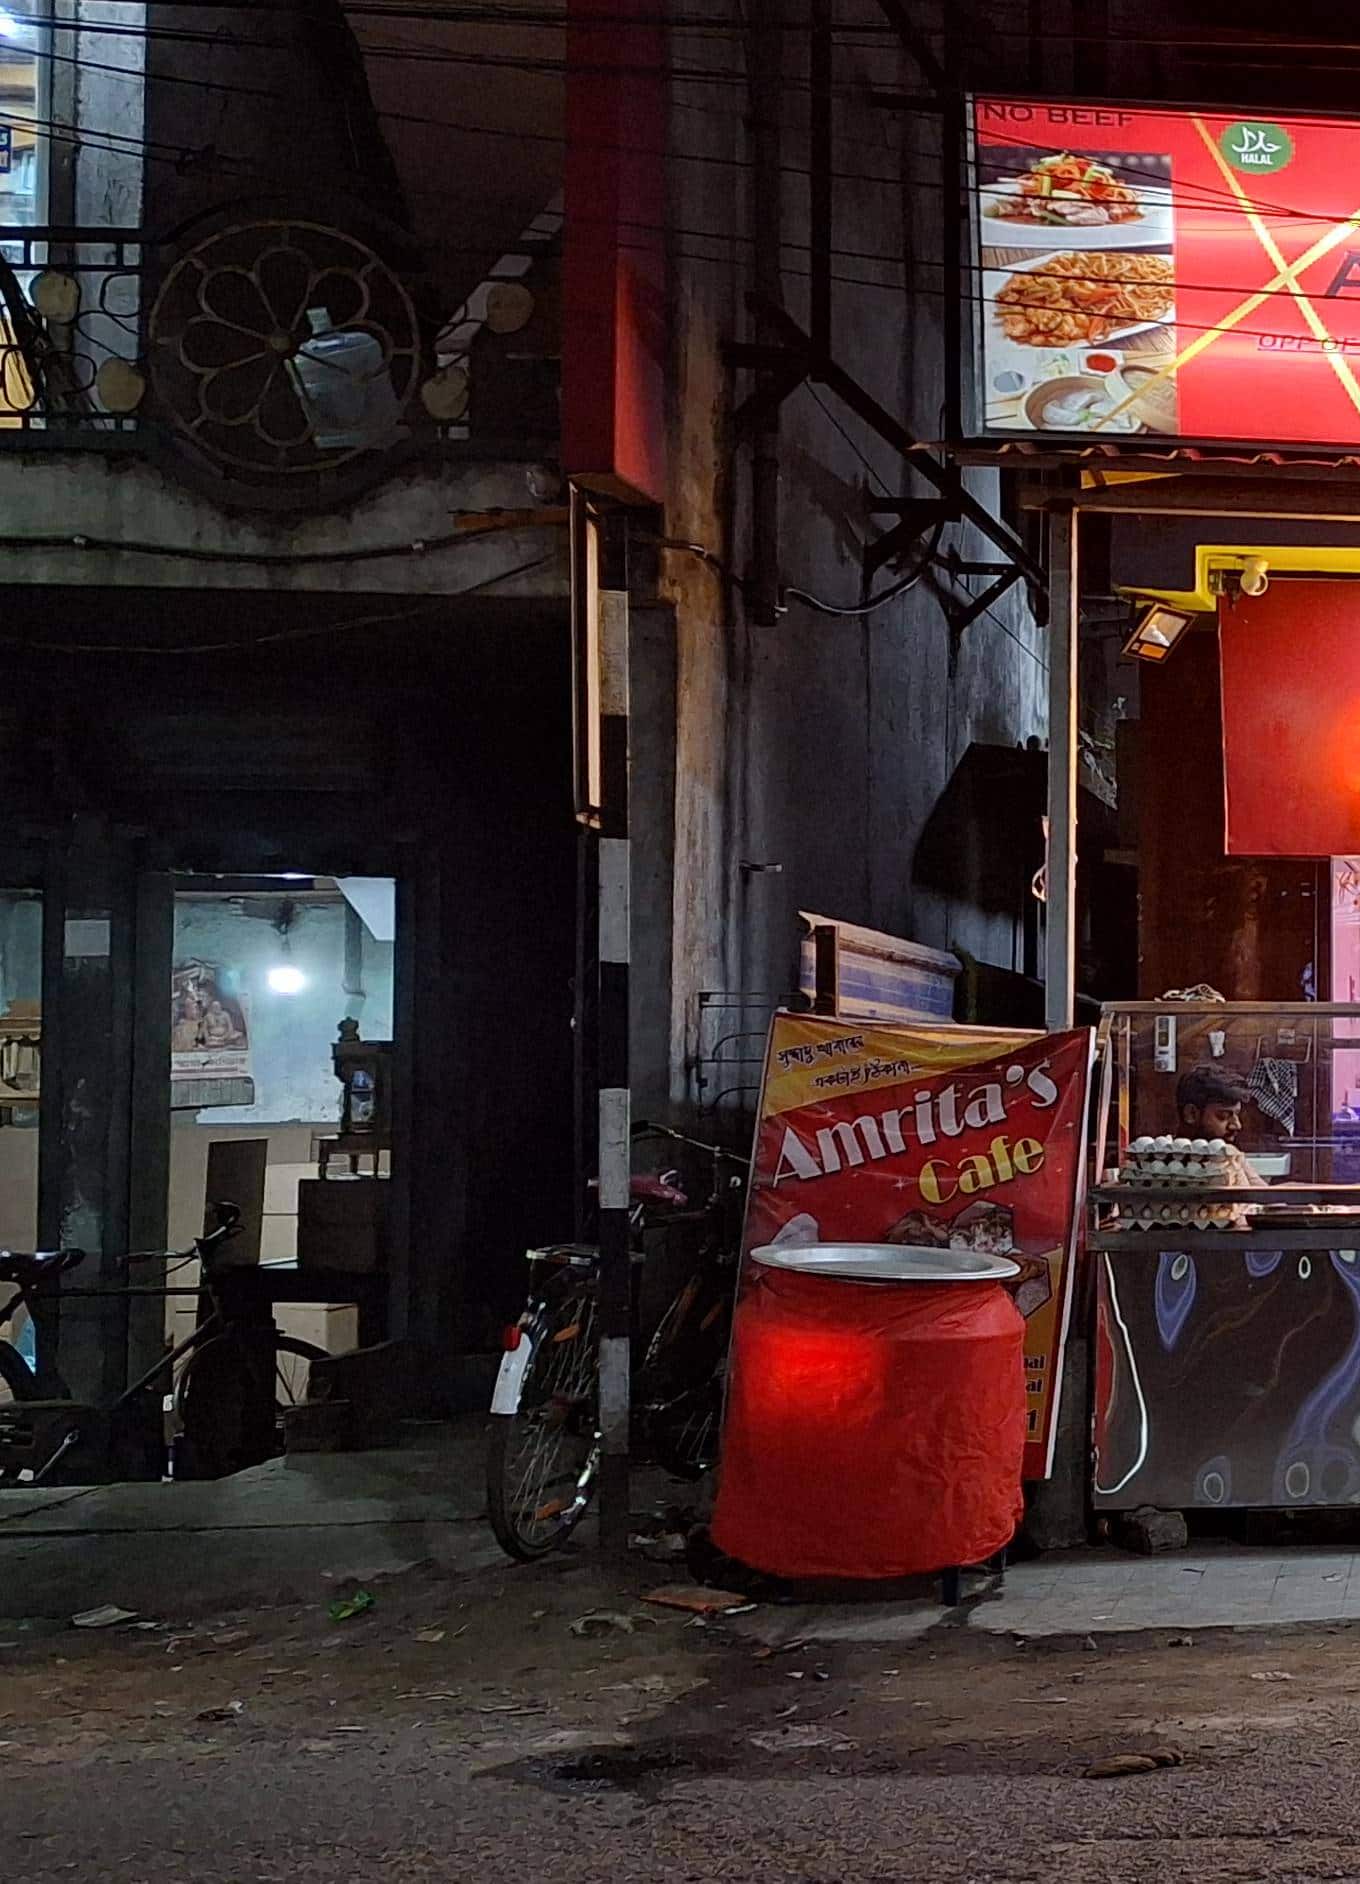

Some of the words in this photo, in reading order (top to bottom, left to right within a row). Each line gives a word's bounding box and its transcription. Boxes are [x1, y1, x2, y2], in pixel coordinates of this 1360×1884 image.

[983, 103, 1034, 123] NO
[1048, 107, 1133, 128] BEEF
[1241, 153, 1273, 166] HALAL
[1259, 333, 1312, 350] OPP
[1320, 336, 1359, 353] OF
[772, 1060, 1059, 1189] Amrita's
[918, 1135, 1045, 1204] Cafe
